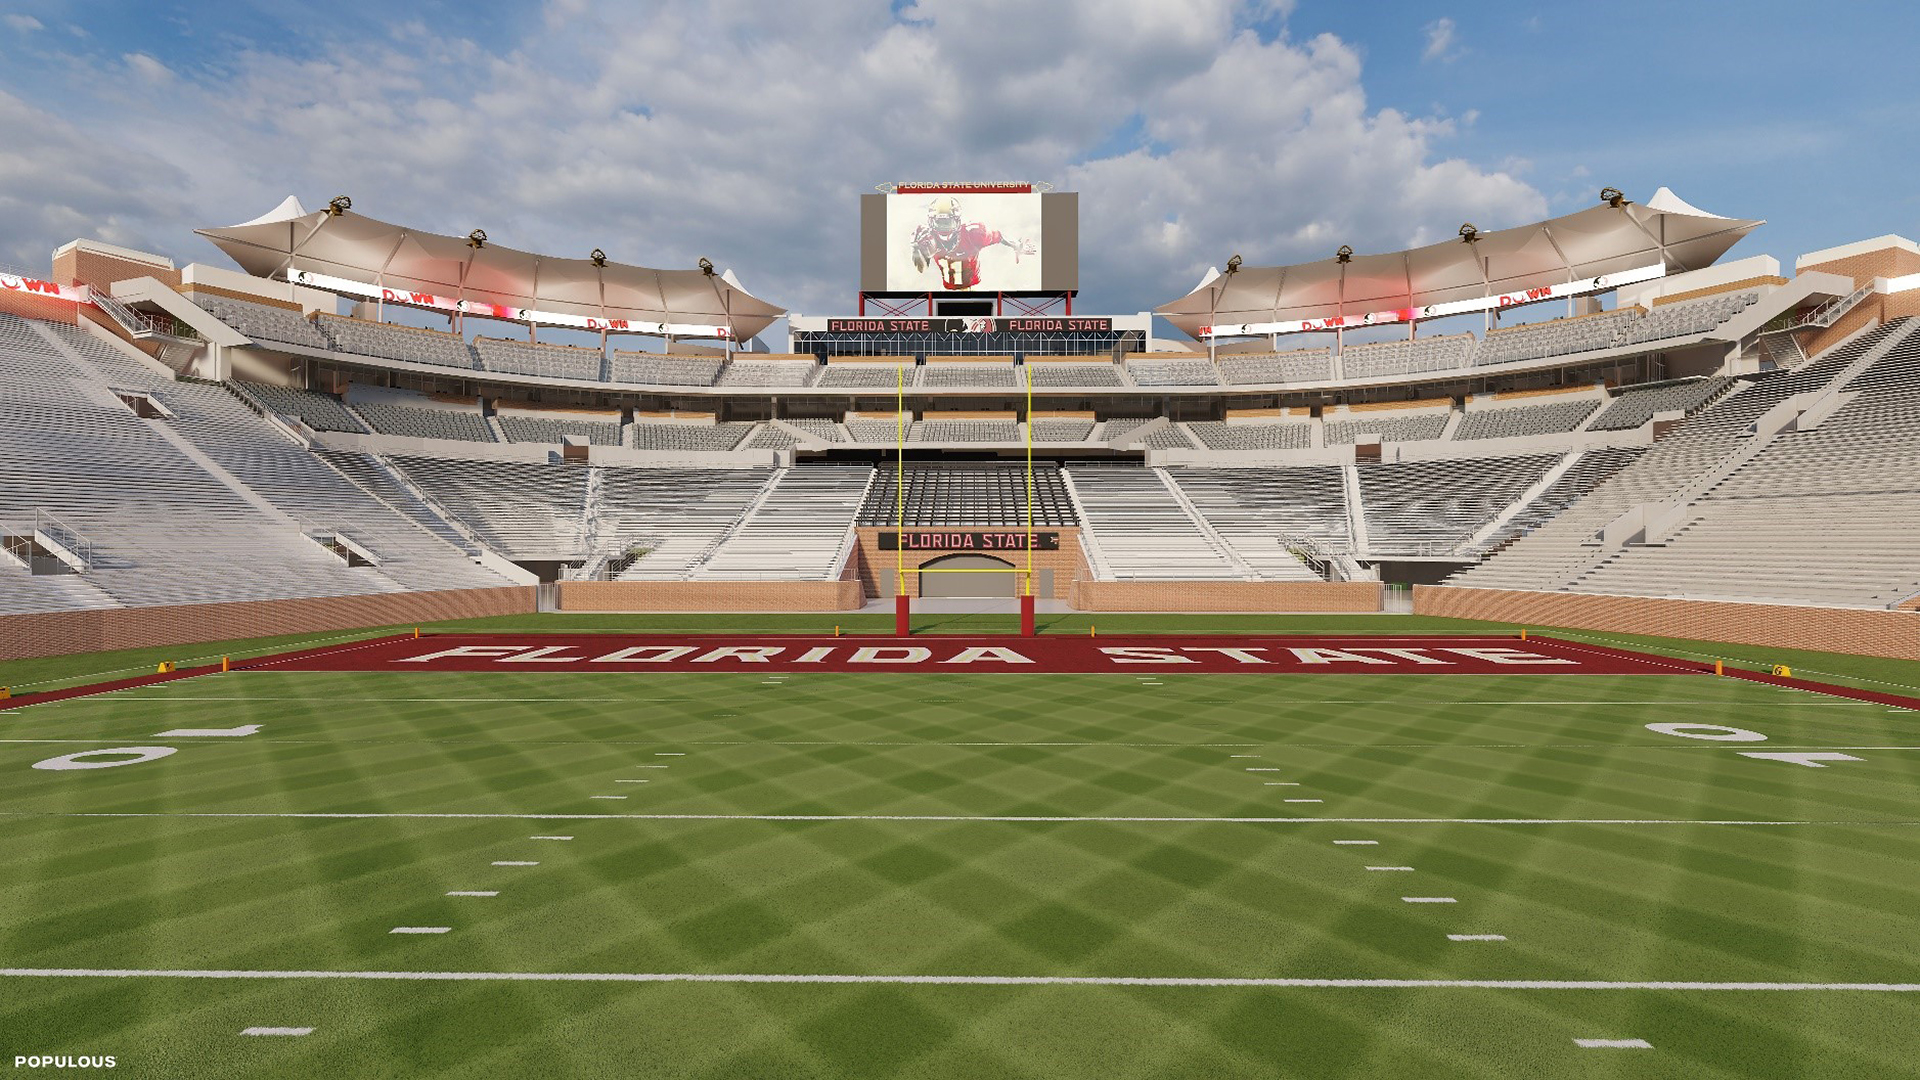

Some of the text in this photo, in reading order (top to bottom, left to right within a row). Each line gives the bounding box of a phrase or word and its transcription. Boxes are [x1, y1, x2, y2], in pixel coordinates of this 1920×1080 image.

[898, 180, 1030, 189] FLORIDA STATE UNIVERSITY
[938, 258, 963, 285] 11
[831, 320, 930, 331] FLORIDA STATE
[1009, 320, 1109, 331] FLORIDA STATE
[898, 533, 1038, 548] FLORIDA STATE
[387, 645, 1582, 664] FLORIDA STATE
